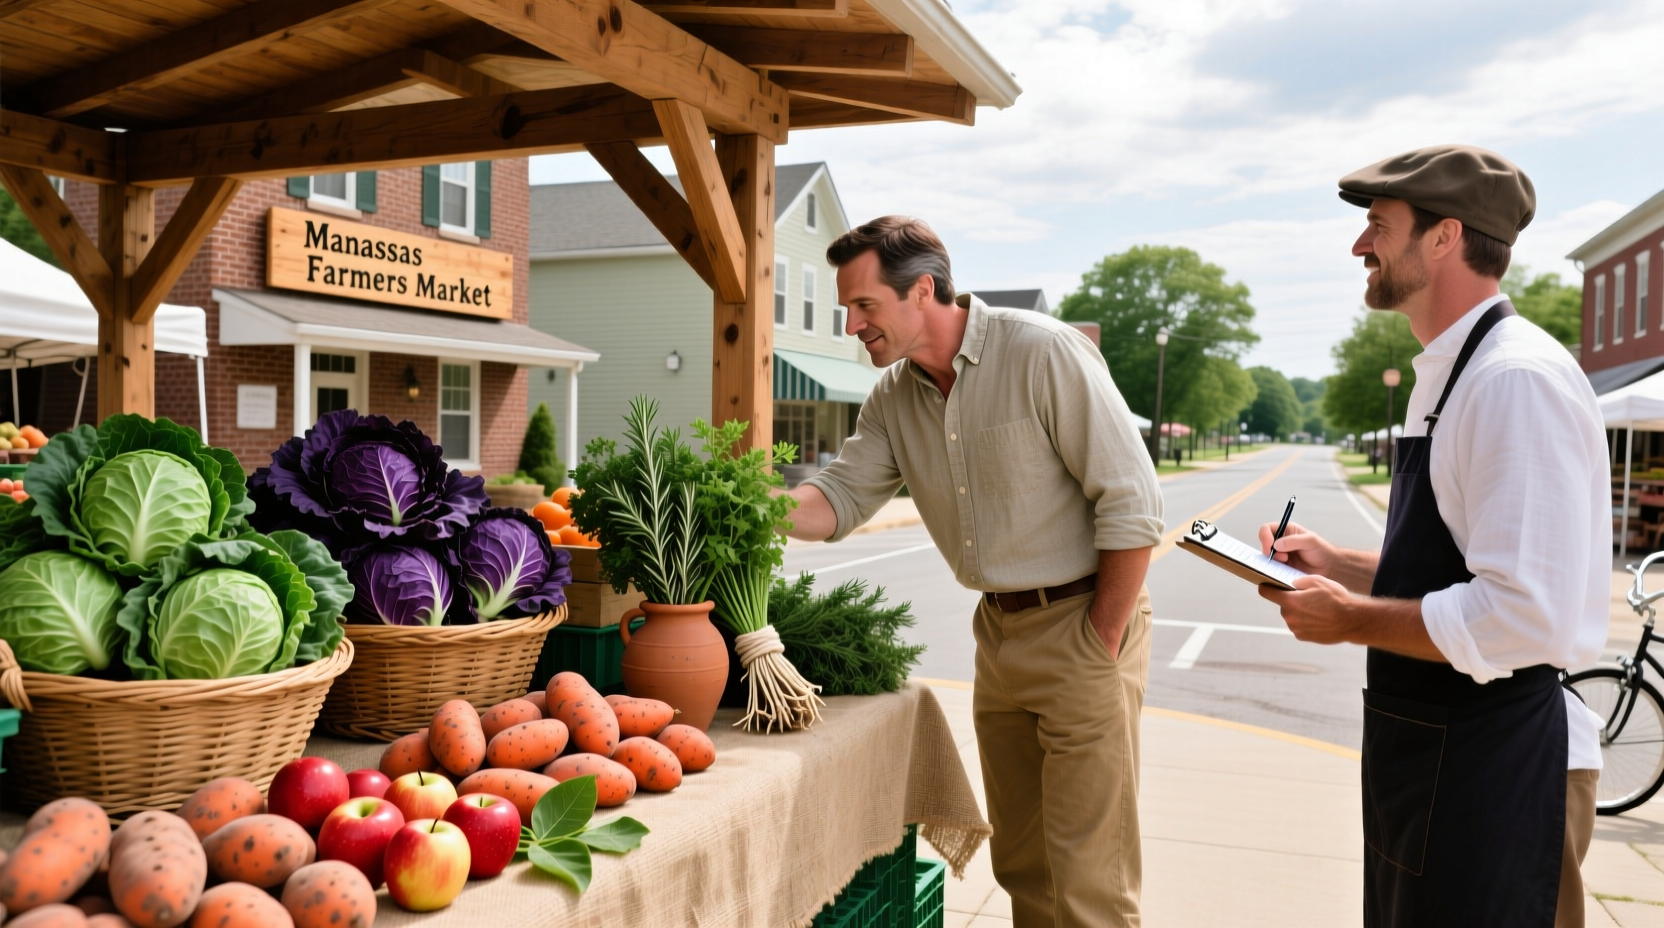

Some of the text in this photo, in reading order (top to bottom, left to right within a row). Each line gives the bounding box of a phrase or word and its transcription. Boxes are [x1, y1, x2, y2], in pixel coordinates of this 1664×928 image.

[304, 220, 423, 266] Manassas
[307, 255, 492, 308] Farmers Market
